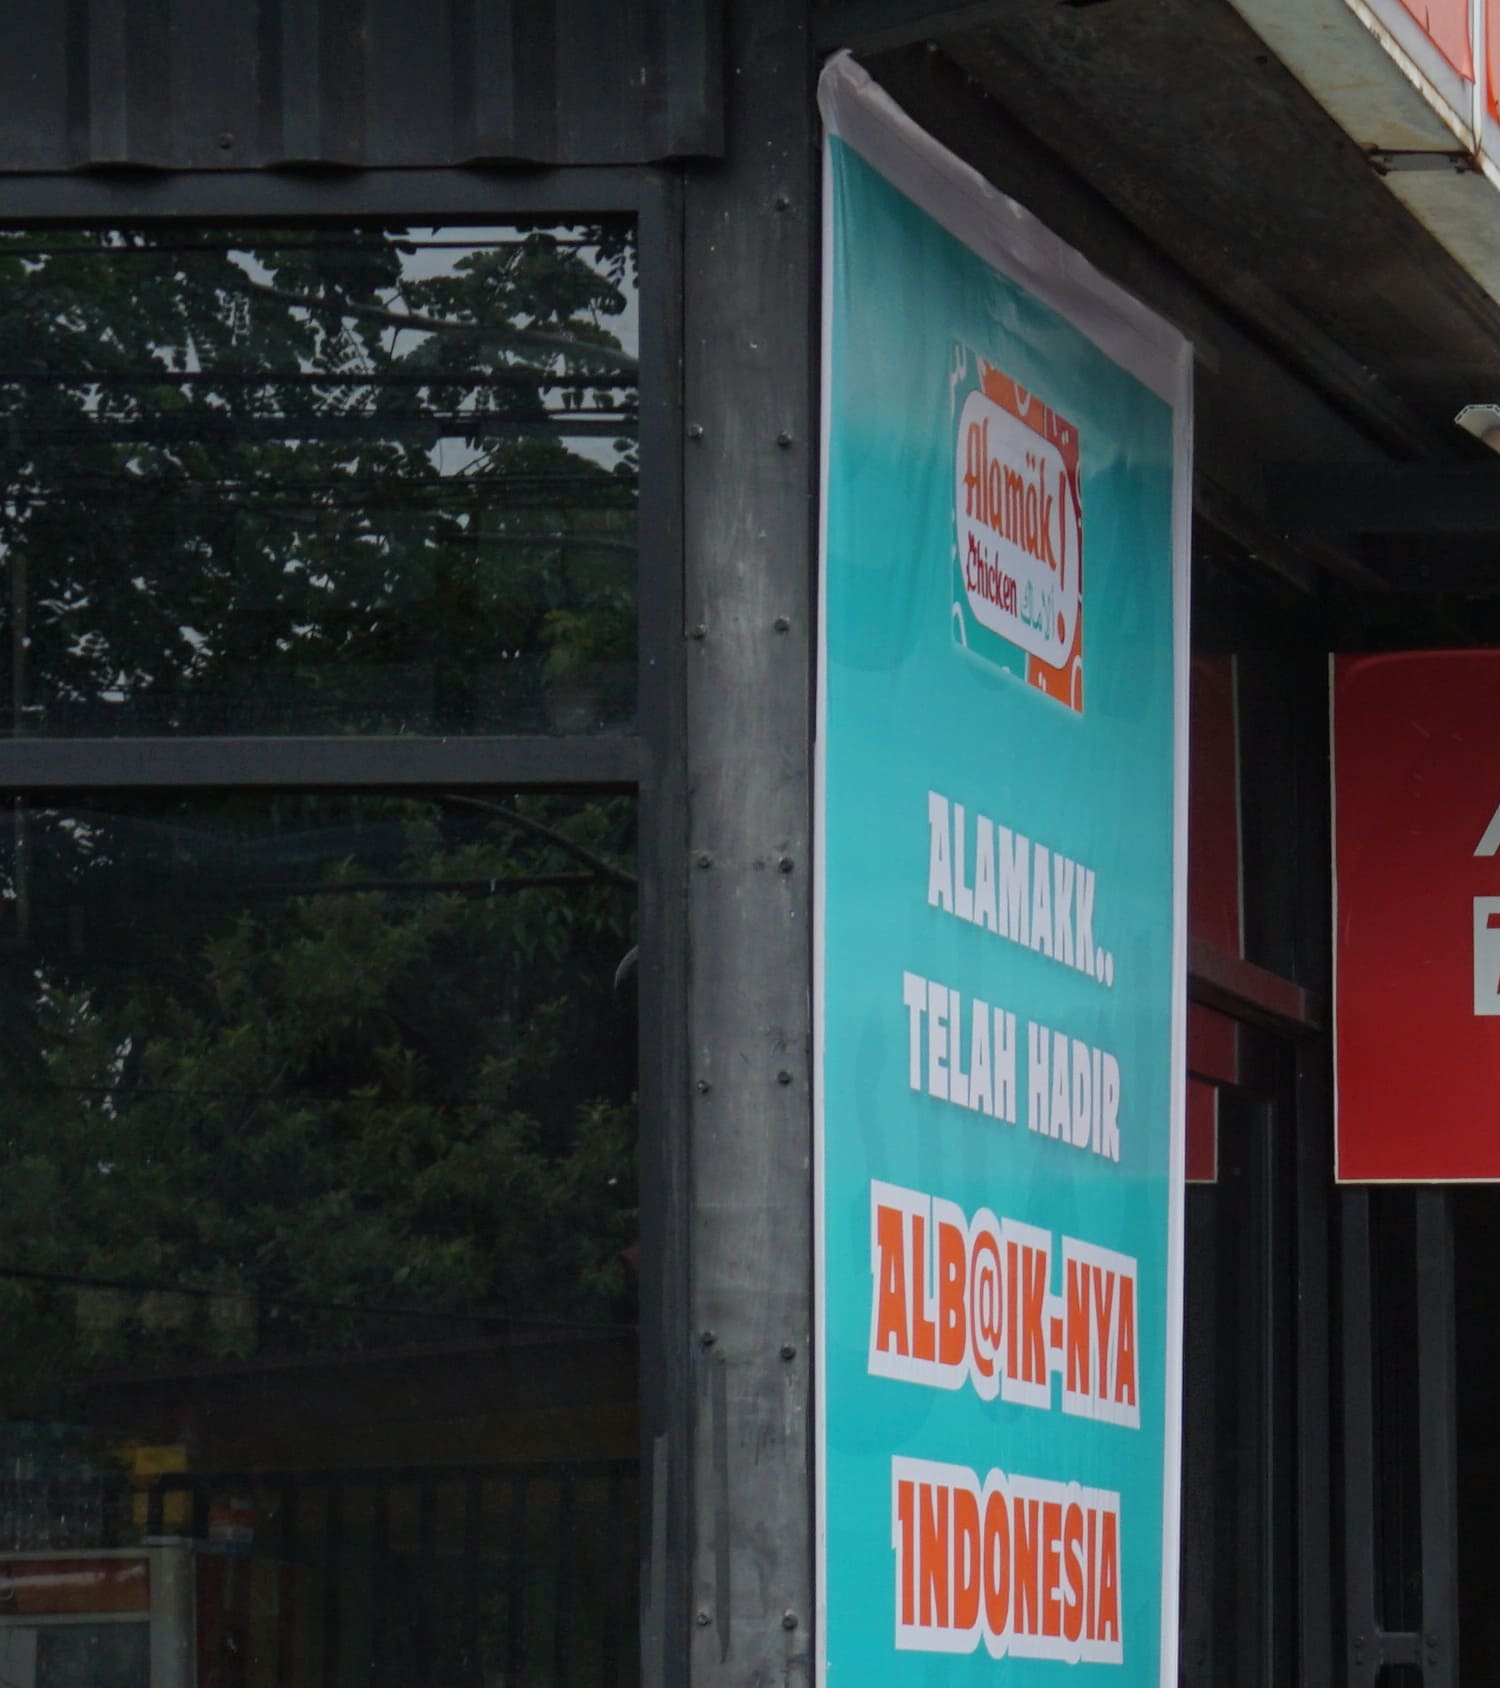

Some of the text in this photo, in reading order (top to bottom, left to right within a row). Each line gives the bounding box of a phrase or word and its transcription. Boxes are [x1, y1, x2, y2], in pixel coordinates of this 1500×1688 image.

[966, 530, 1018, 618] Chicken
[928, 790, 1114, 988] ALAMAKK..
[903, 970, 1120, 1163] TELAH HADIR
[876, 1204, 1136, 1406] ALB@IK-NYA
[898, 1479, 1119, 1642] INDONESIA
